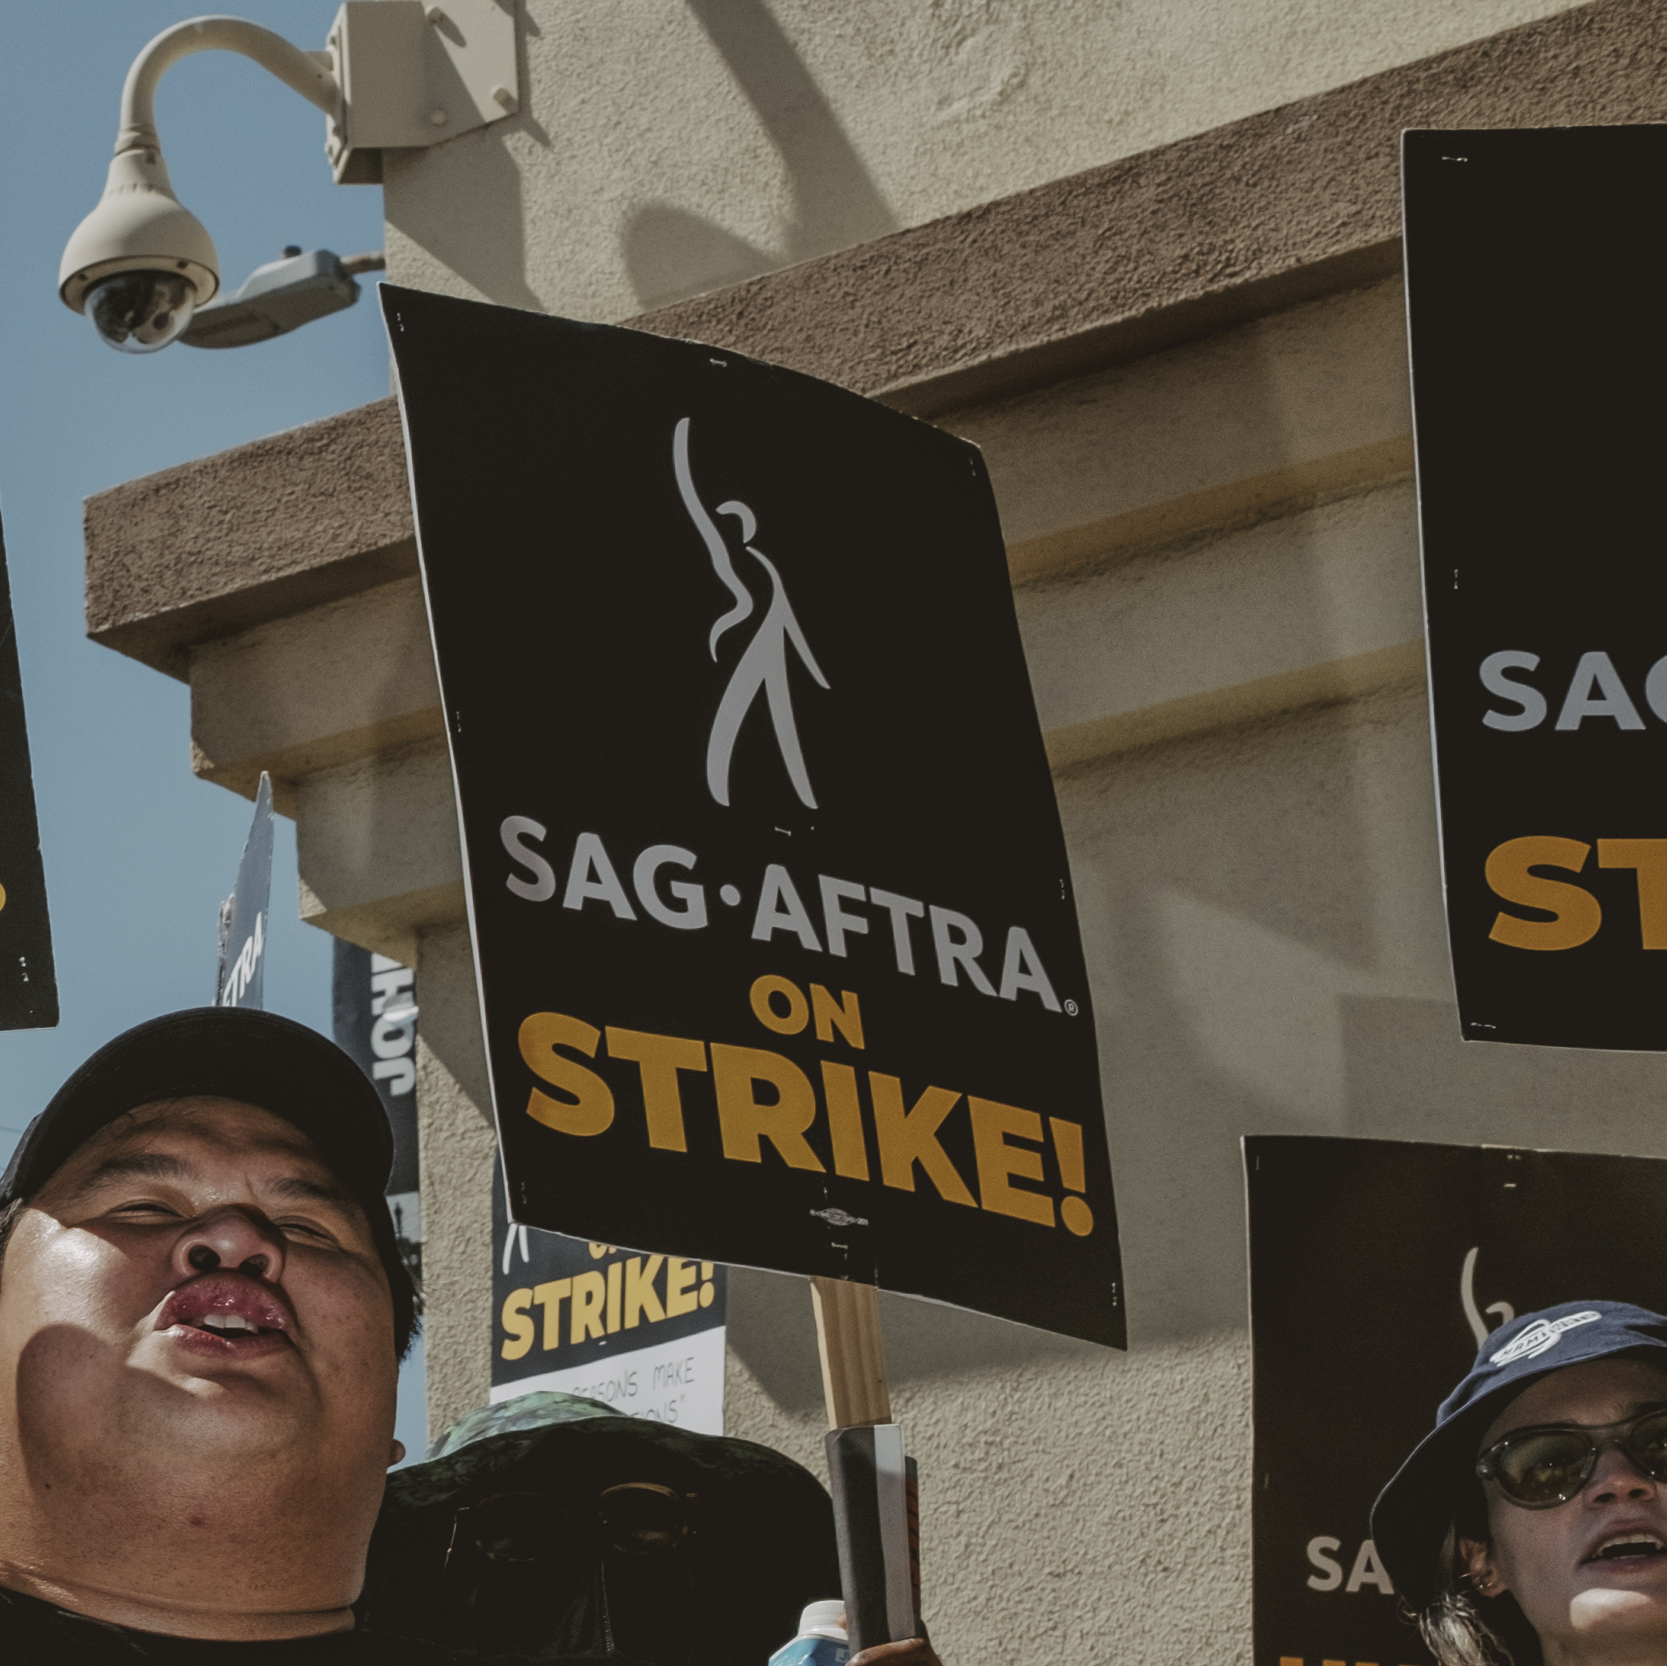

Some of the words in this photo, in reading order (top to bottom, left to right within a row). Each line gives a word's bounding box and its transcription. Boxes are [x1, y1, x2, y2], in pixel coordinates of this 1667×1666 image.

[749, 974, 866, 1050] ON
[517, 1011, 1095, 1237] STRIKE!
[500, 1254, 716, 1362] STRIKE!
